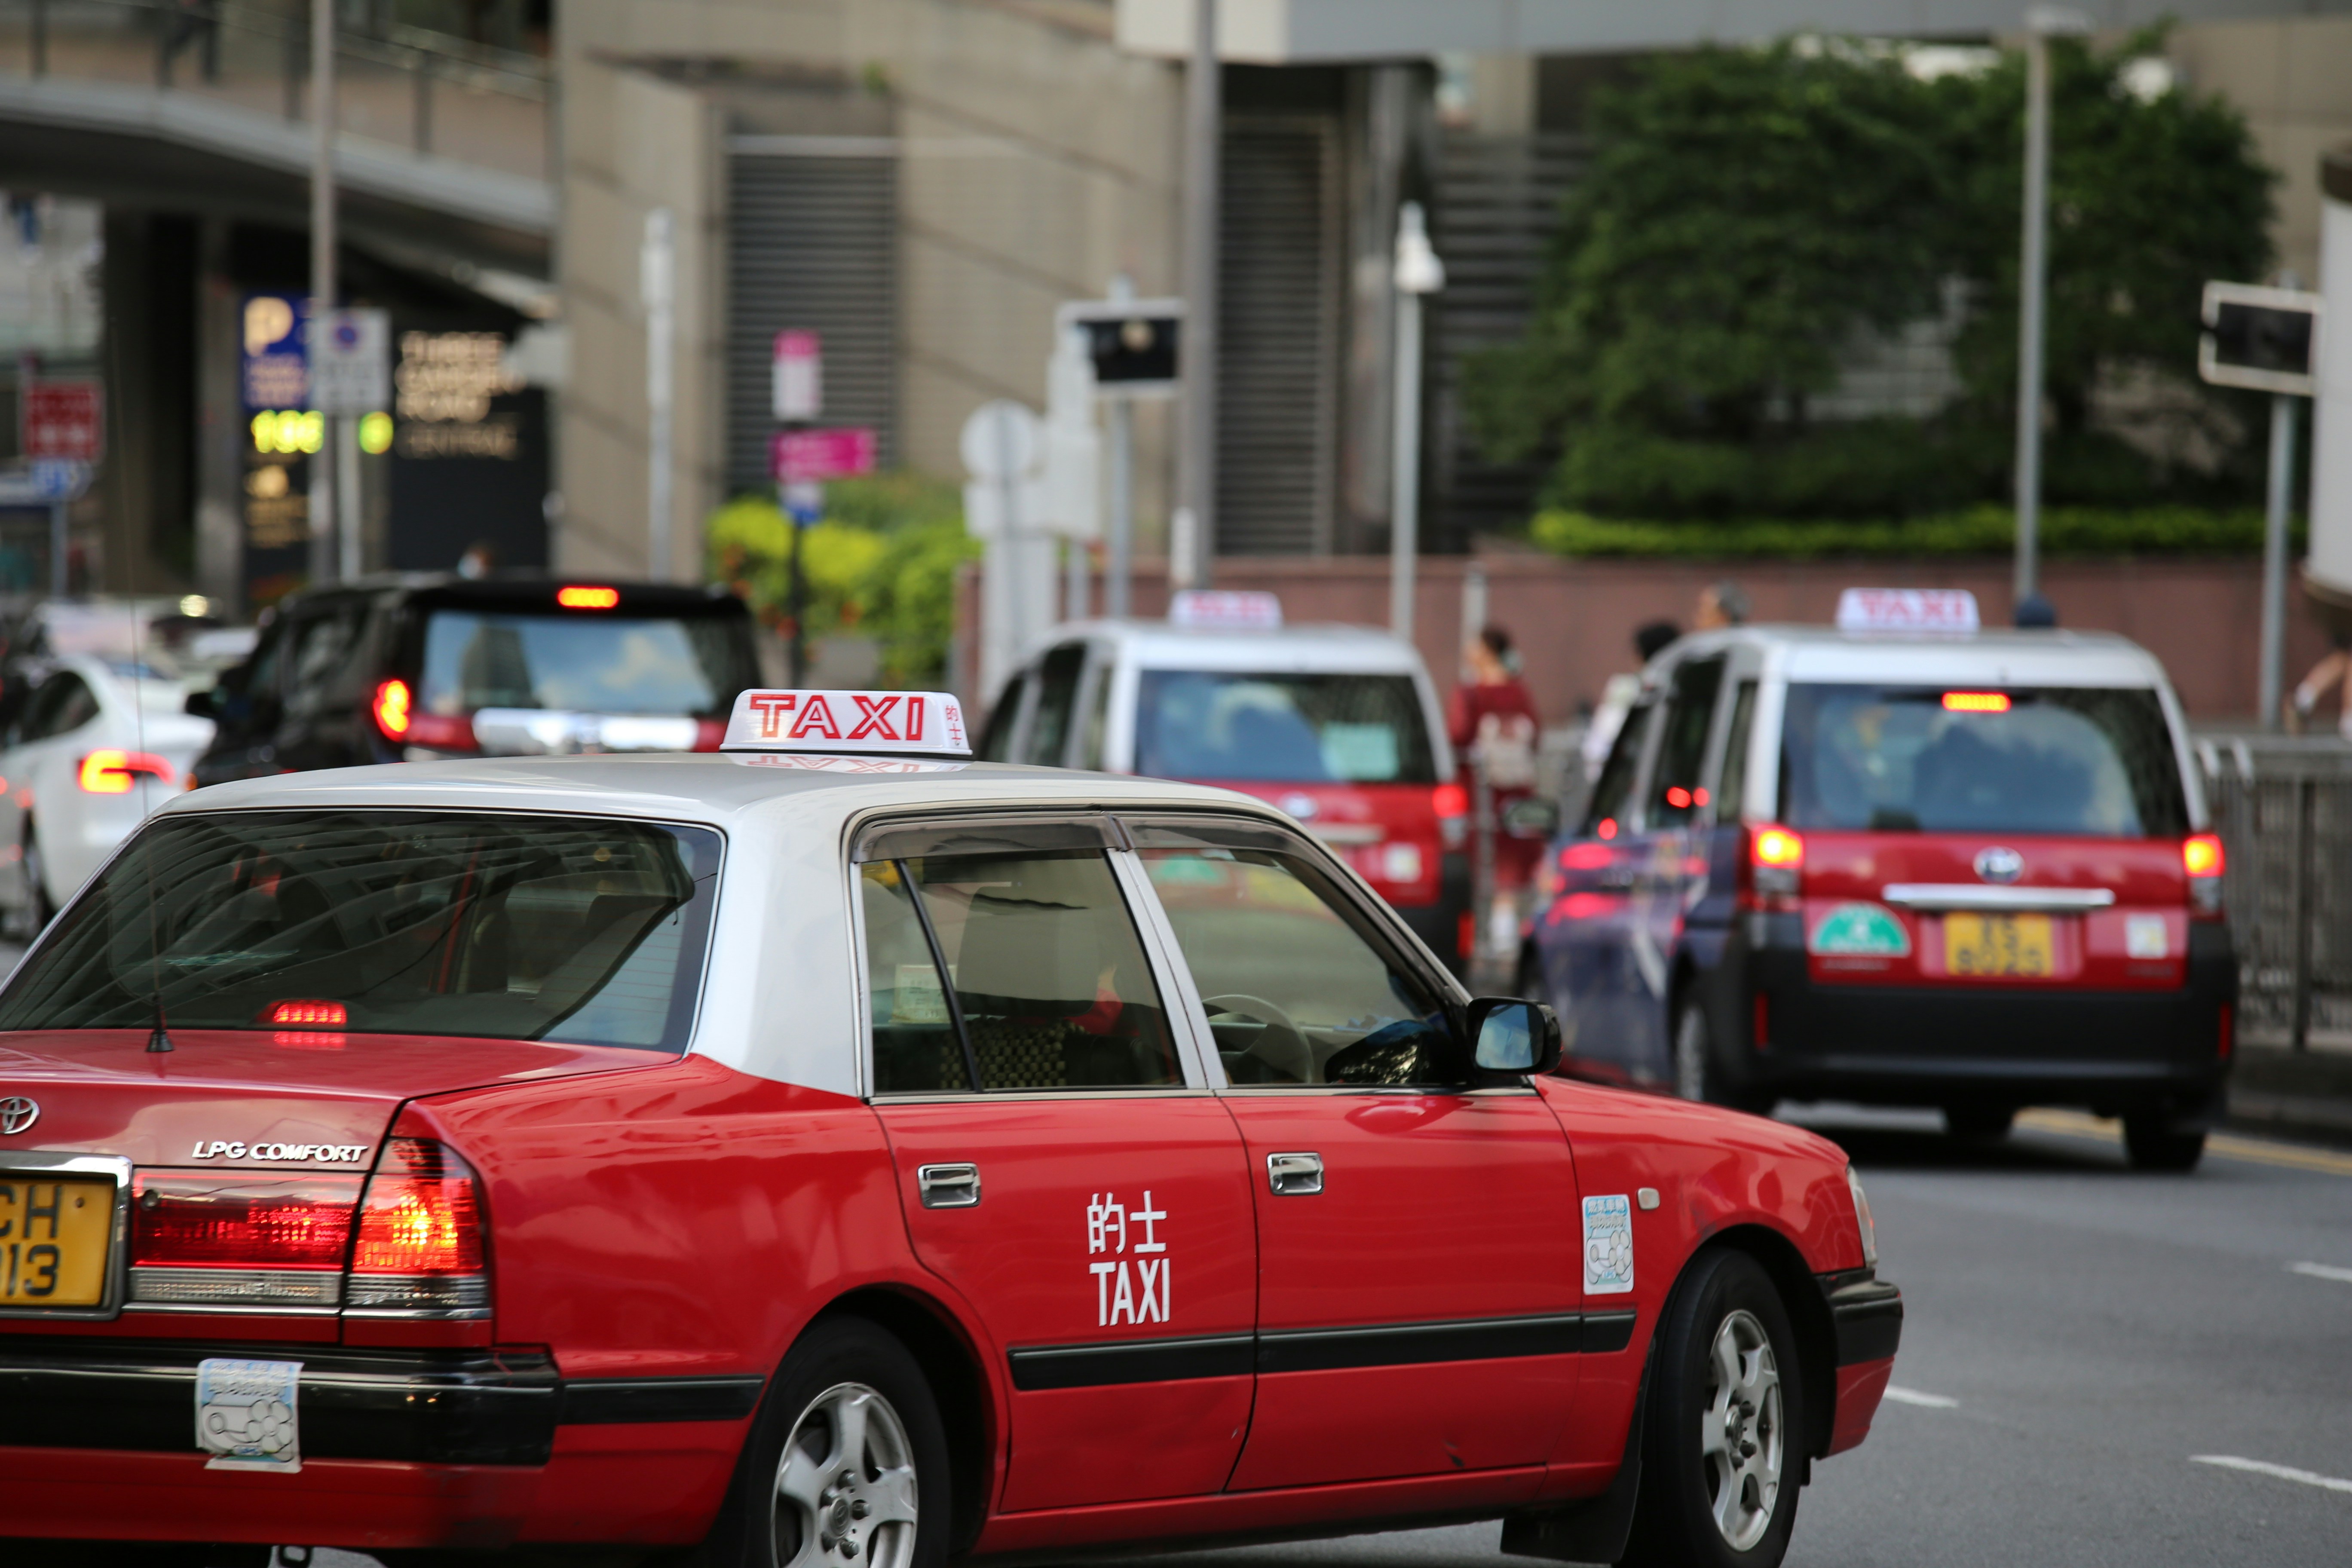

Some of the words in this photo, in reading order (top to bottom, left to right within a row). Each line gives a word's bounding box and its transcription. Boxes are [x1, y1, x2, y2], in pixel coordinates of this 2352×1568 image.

[750, 694, 925, 741] TAXI
[945, 705, 962, 740] 的士
[192, 1141, 248, 1159] LPG
[249, 1143, 369, 1162] COMFORT
[1086, 1190, 1167, 1255] 的士
[0, 1243, 61, 1297] 13
[1089, 1258, 1170, 1327] TAXI
